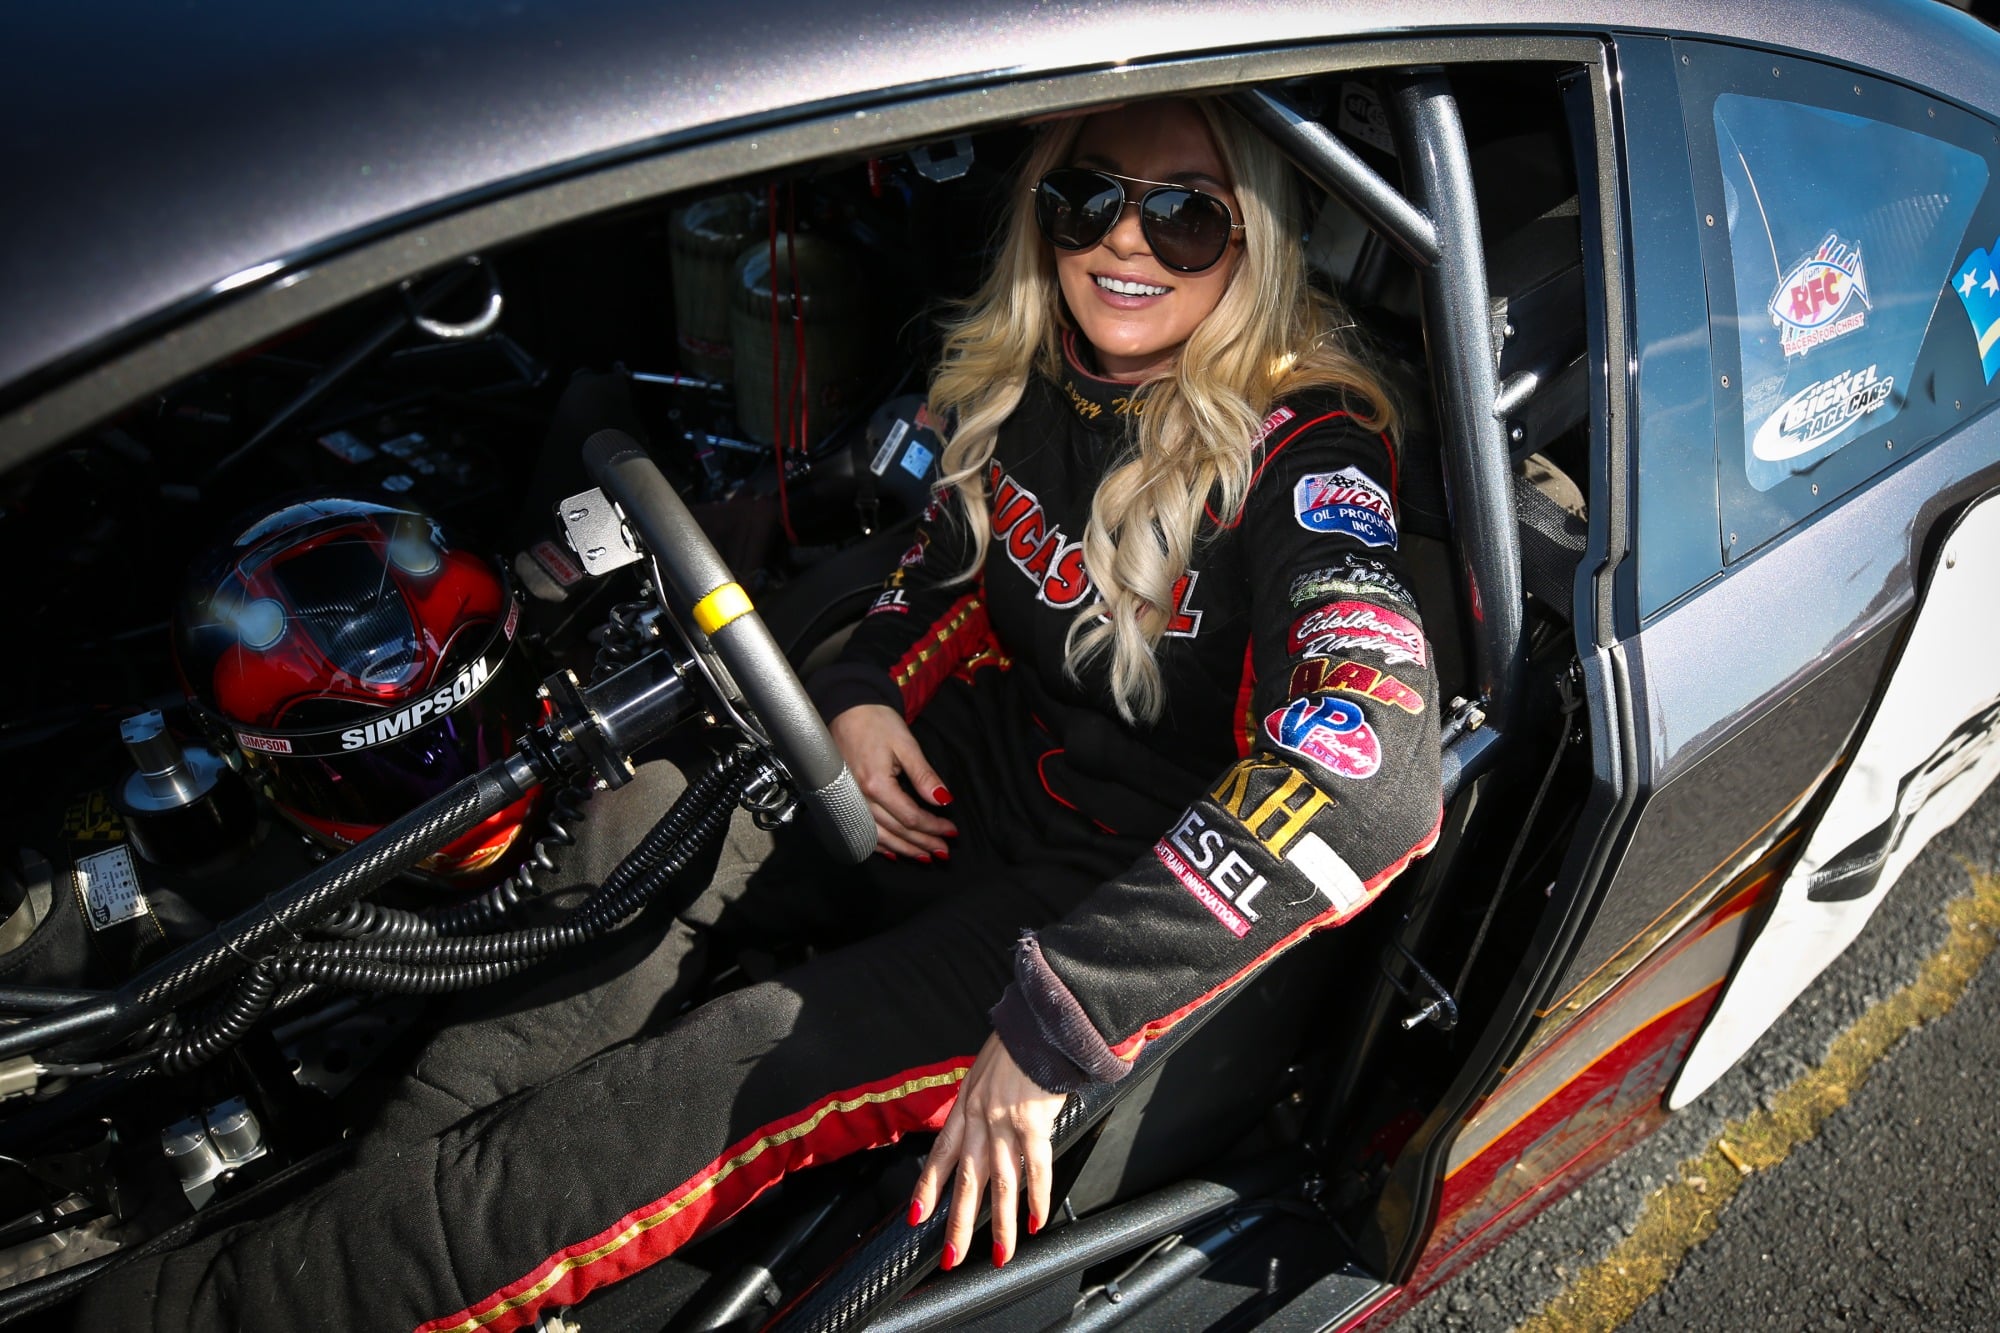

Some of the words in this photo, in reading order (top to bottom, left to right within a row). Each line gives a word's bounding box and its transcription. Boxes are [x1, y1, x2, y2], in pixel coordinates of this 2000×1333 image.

[1790, 271, 1840, 321] RFC
[1785, 333, 1818, 354] RACERS
[1819, 326, 1836, 340] FOR
[1836, 314, 1865, 334] CHRIST
[1784, 364, 1877, 431] BICKEL
[1801, 404, 1846, 440] RACE
[1847, 378, 1893, 412] CARS
[1310, 487, 1392, 521] LUCAS
[1313, 509, 1335, 523] OIL
[1352, 520, 1376, 537] INC.
[340, 655, 488, 751] SIMPSON
[1280, 697, 1364, 750] VP
[240, 733, 290, 752] SIMPSON
[1169, 807, 1267, 922] ESEL
